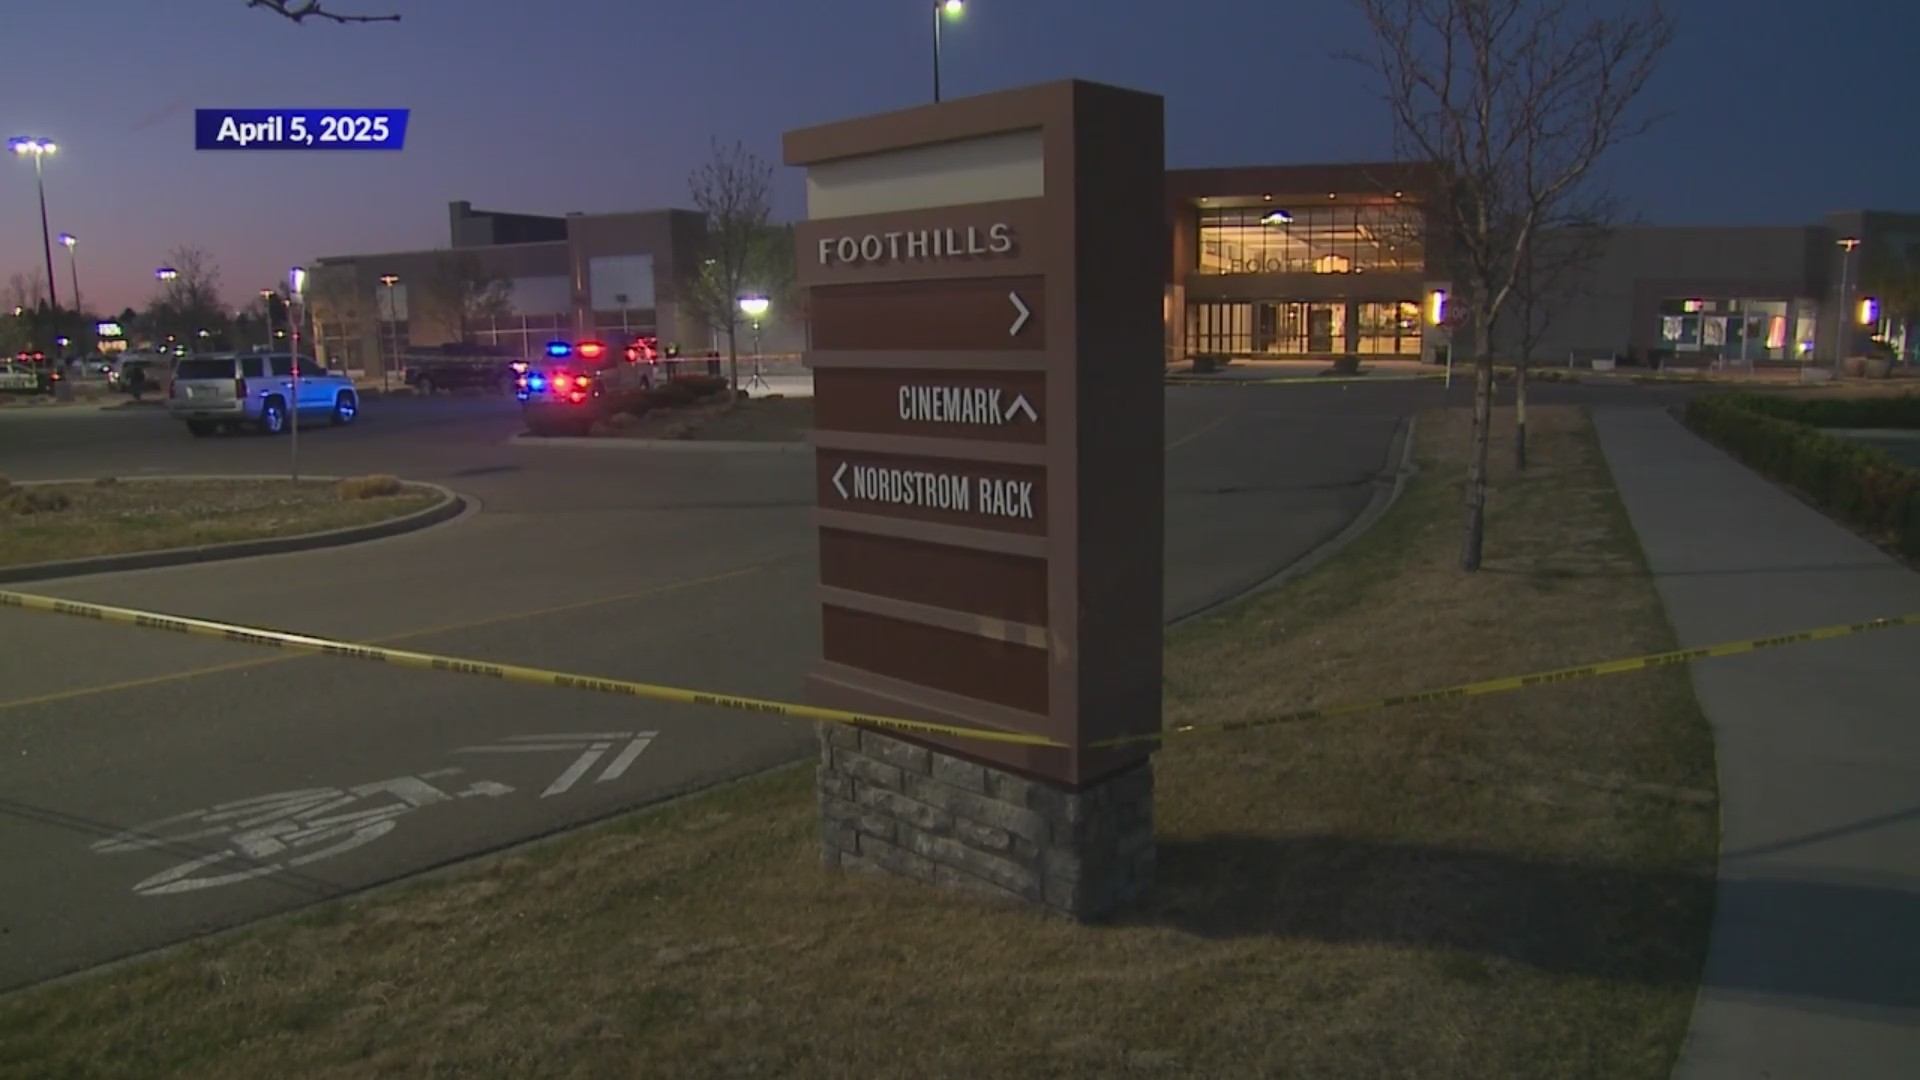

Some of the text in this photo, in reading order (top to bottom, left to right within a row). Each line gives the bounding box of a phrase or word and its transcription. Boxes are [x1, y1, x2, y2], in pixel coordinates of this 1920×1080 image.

[818, 223, 1013, 265] FOOTHILLS
[899, 384, 1002, 425] CINEMARK
[853, 465, 1033, 519] NORDSTROM RACK
